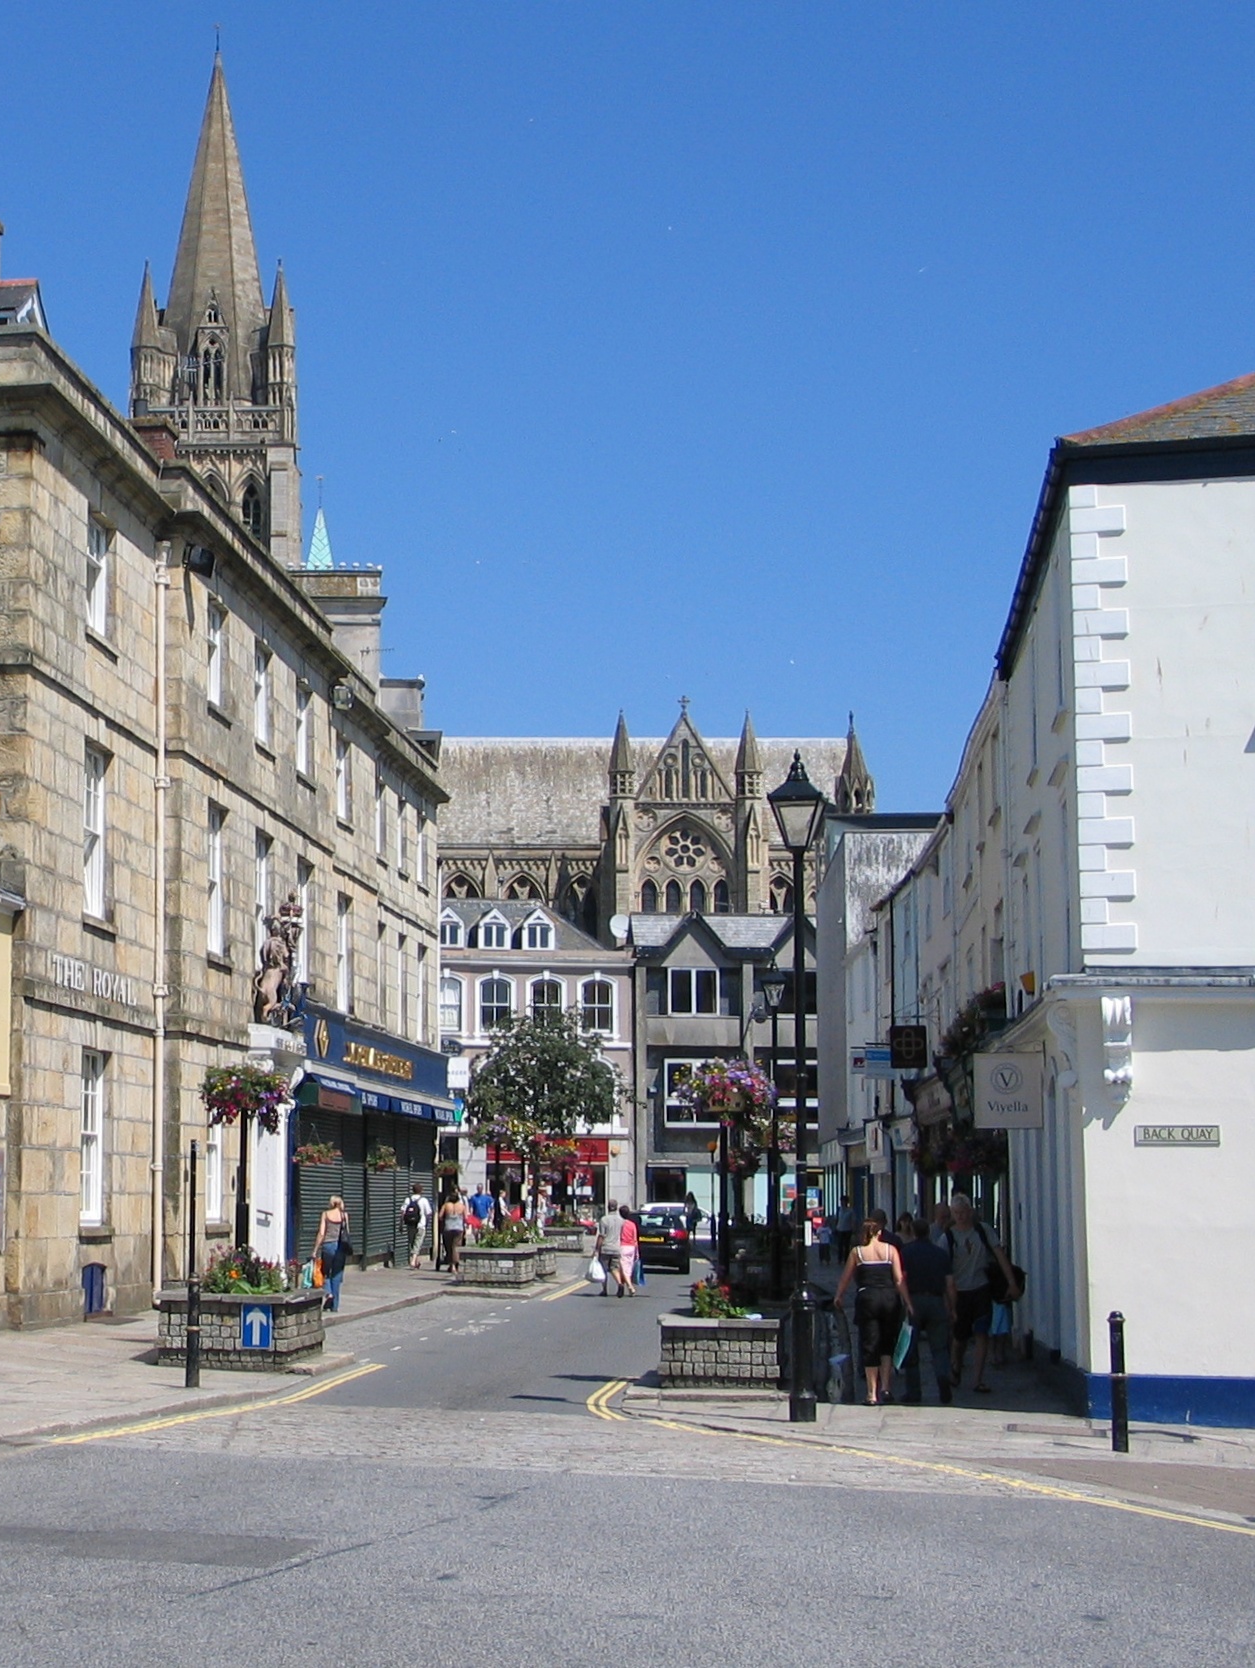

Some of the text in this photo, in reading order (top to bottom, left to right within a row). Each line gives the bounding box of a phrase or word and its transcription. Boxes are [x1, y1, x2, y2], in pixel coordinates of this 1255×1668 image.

[52, 954, 137, 1006] THE ROYAL
[987, 1101, 1029, 1115] Viyella
[1143, 1127, 1214, 1141] BACK QUAY
